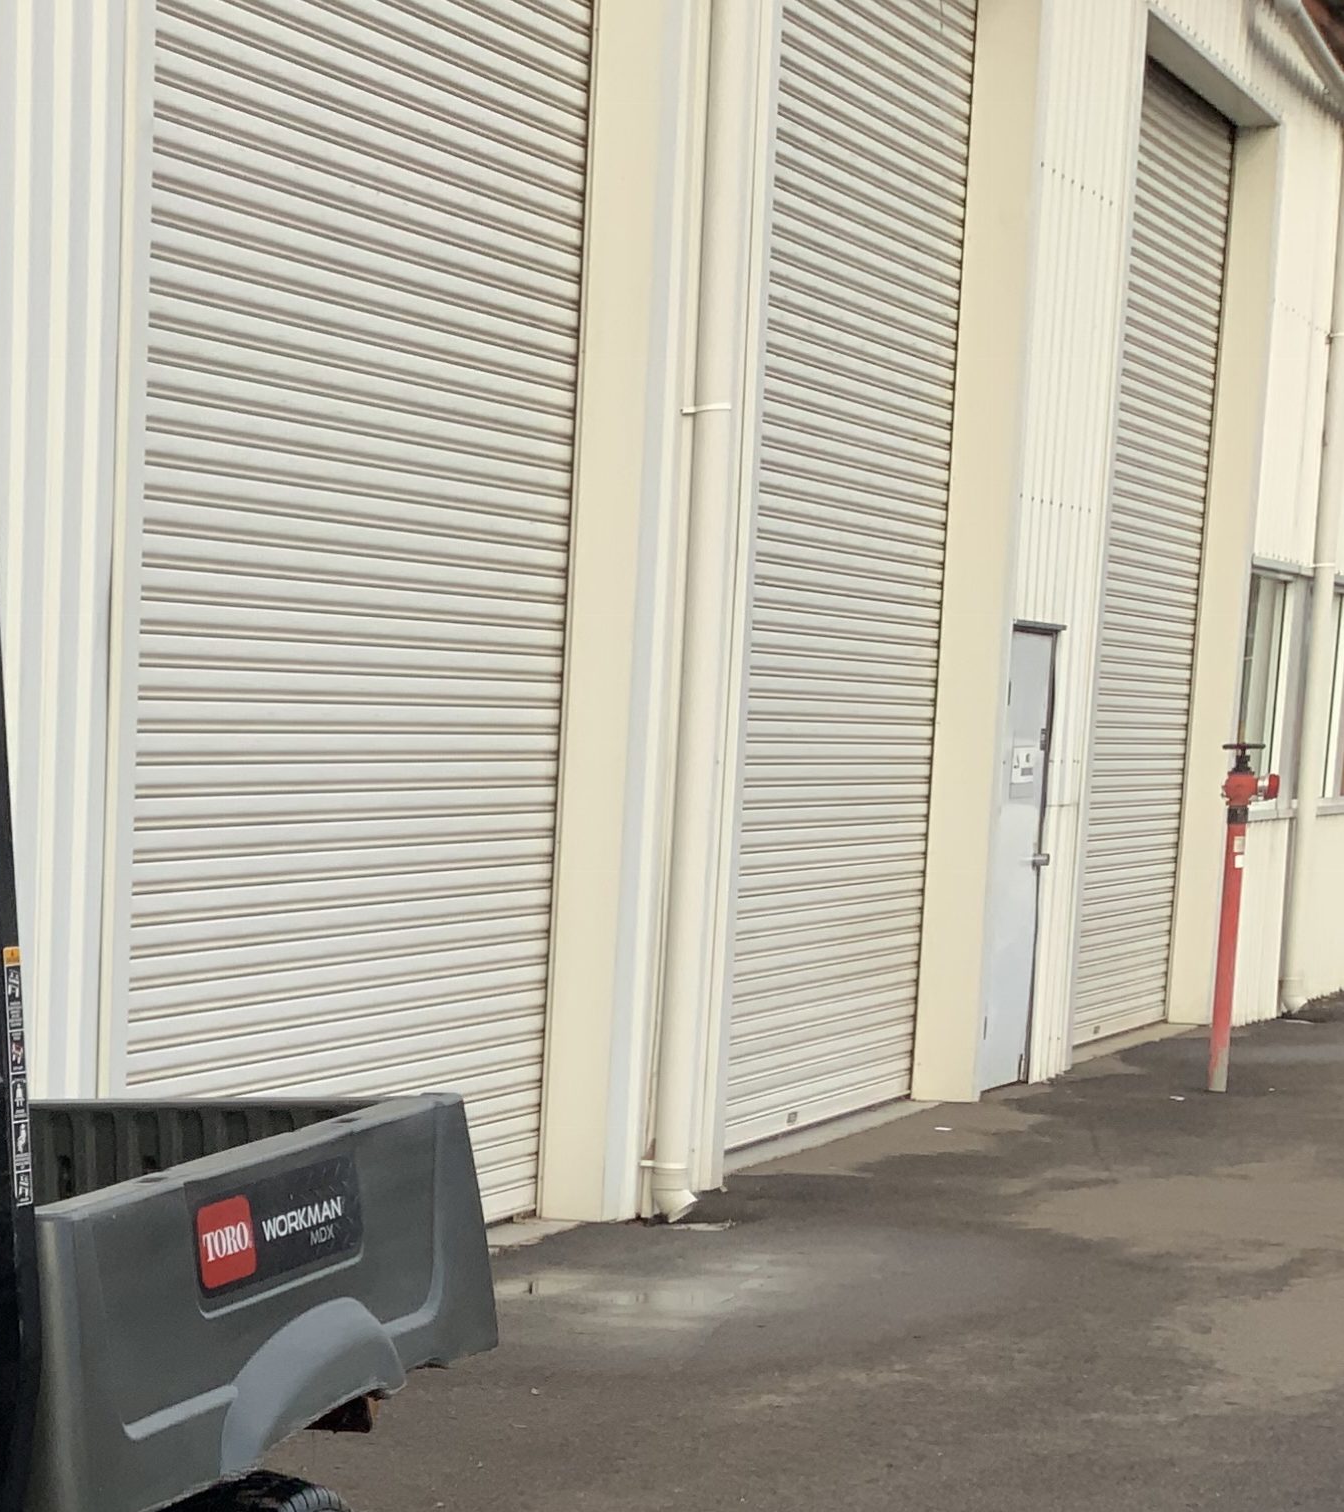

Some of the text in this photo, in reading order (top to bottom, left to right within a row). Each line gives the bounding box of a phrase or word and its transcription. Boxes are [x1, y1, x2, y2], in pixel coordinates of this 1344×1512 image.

[262, 1196, 342, 1242] WORKMAN
[310, 1224, 335, 1246] MDX
[203, 1221, 250, 1262] TORO
